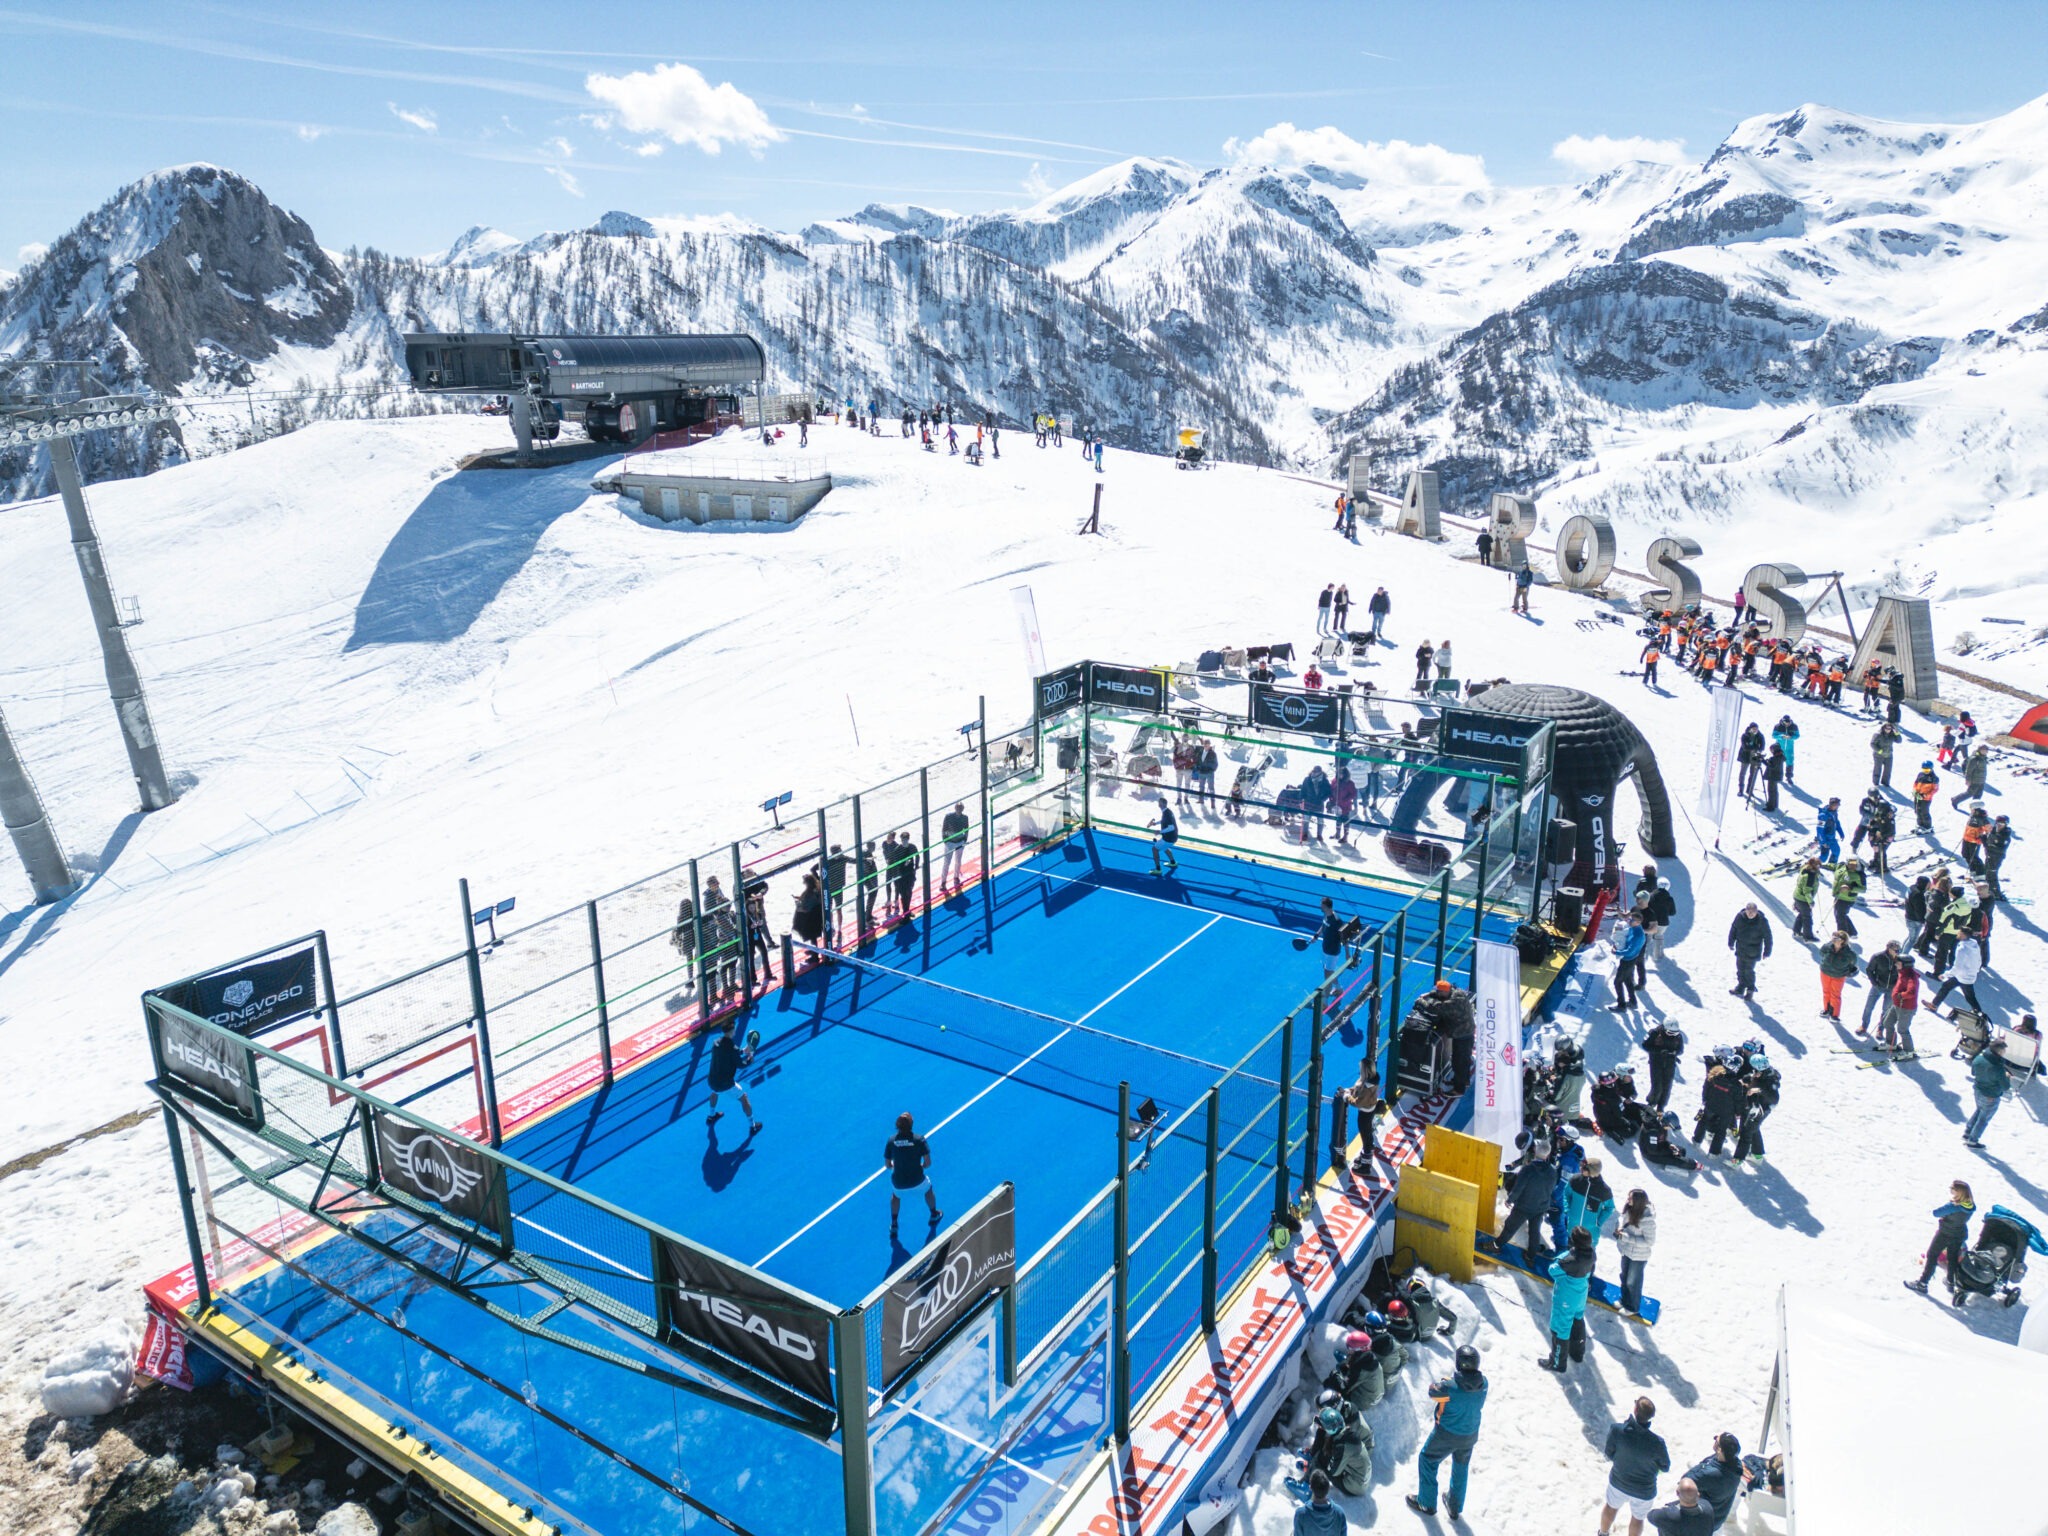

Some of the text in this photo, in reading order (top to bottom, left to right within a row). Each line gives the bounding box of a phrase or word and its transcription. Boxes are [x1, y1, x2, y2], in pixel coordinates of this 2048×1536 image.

[1096, 679, 1156, 697] HEAD
[1284, 705, 1306, 717] MINI
[1592, 816, 1606, 885] HEAD
[205, 984, 304, 1025] TONEVOSO
[167, 1037, 242, 1089] HEAD
[414, 1156, 450, 1184] MINI
[974, 1247, 1015, 1281] MARIANI
[677, 1277, 817, 1362] HEAD
[1149, 1287, 1297, 1447] TUTTOSPORT
